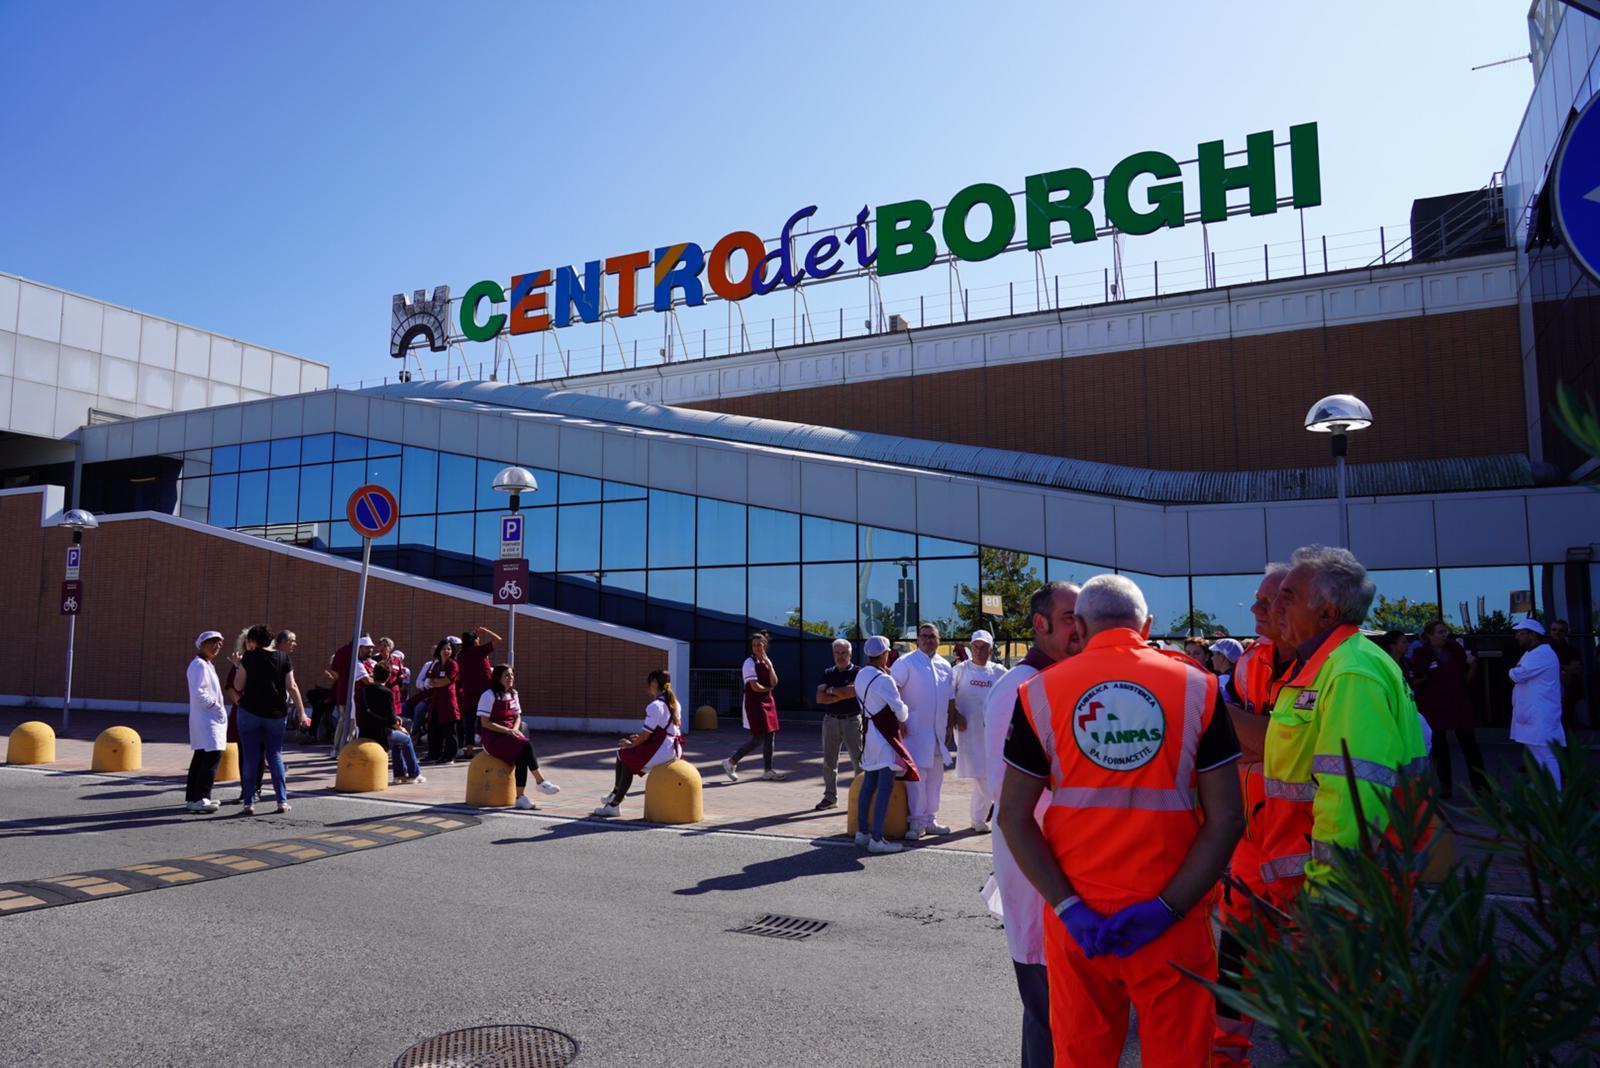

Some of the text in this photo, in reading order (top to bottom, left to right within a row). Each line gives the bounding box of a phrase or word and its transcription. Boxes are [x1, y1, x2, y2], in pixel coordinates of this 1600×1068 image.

[460, 121, 1321, 342] CENTRO dei BORGHI
[506, 521, 517, 539] P
[1078, 683, 1156, 711] PUBBLICA ASSISTENZA
[1104, 728, 1161, 744] ANPAS
[1103, 746, 1153, 765] FORNACETTE
